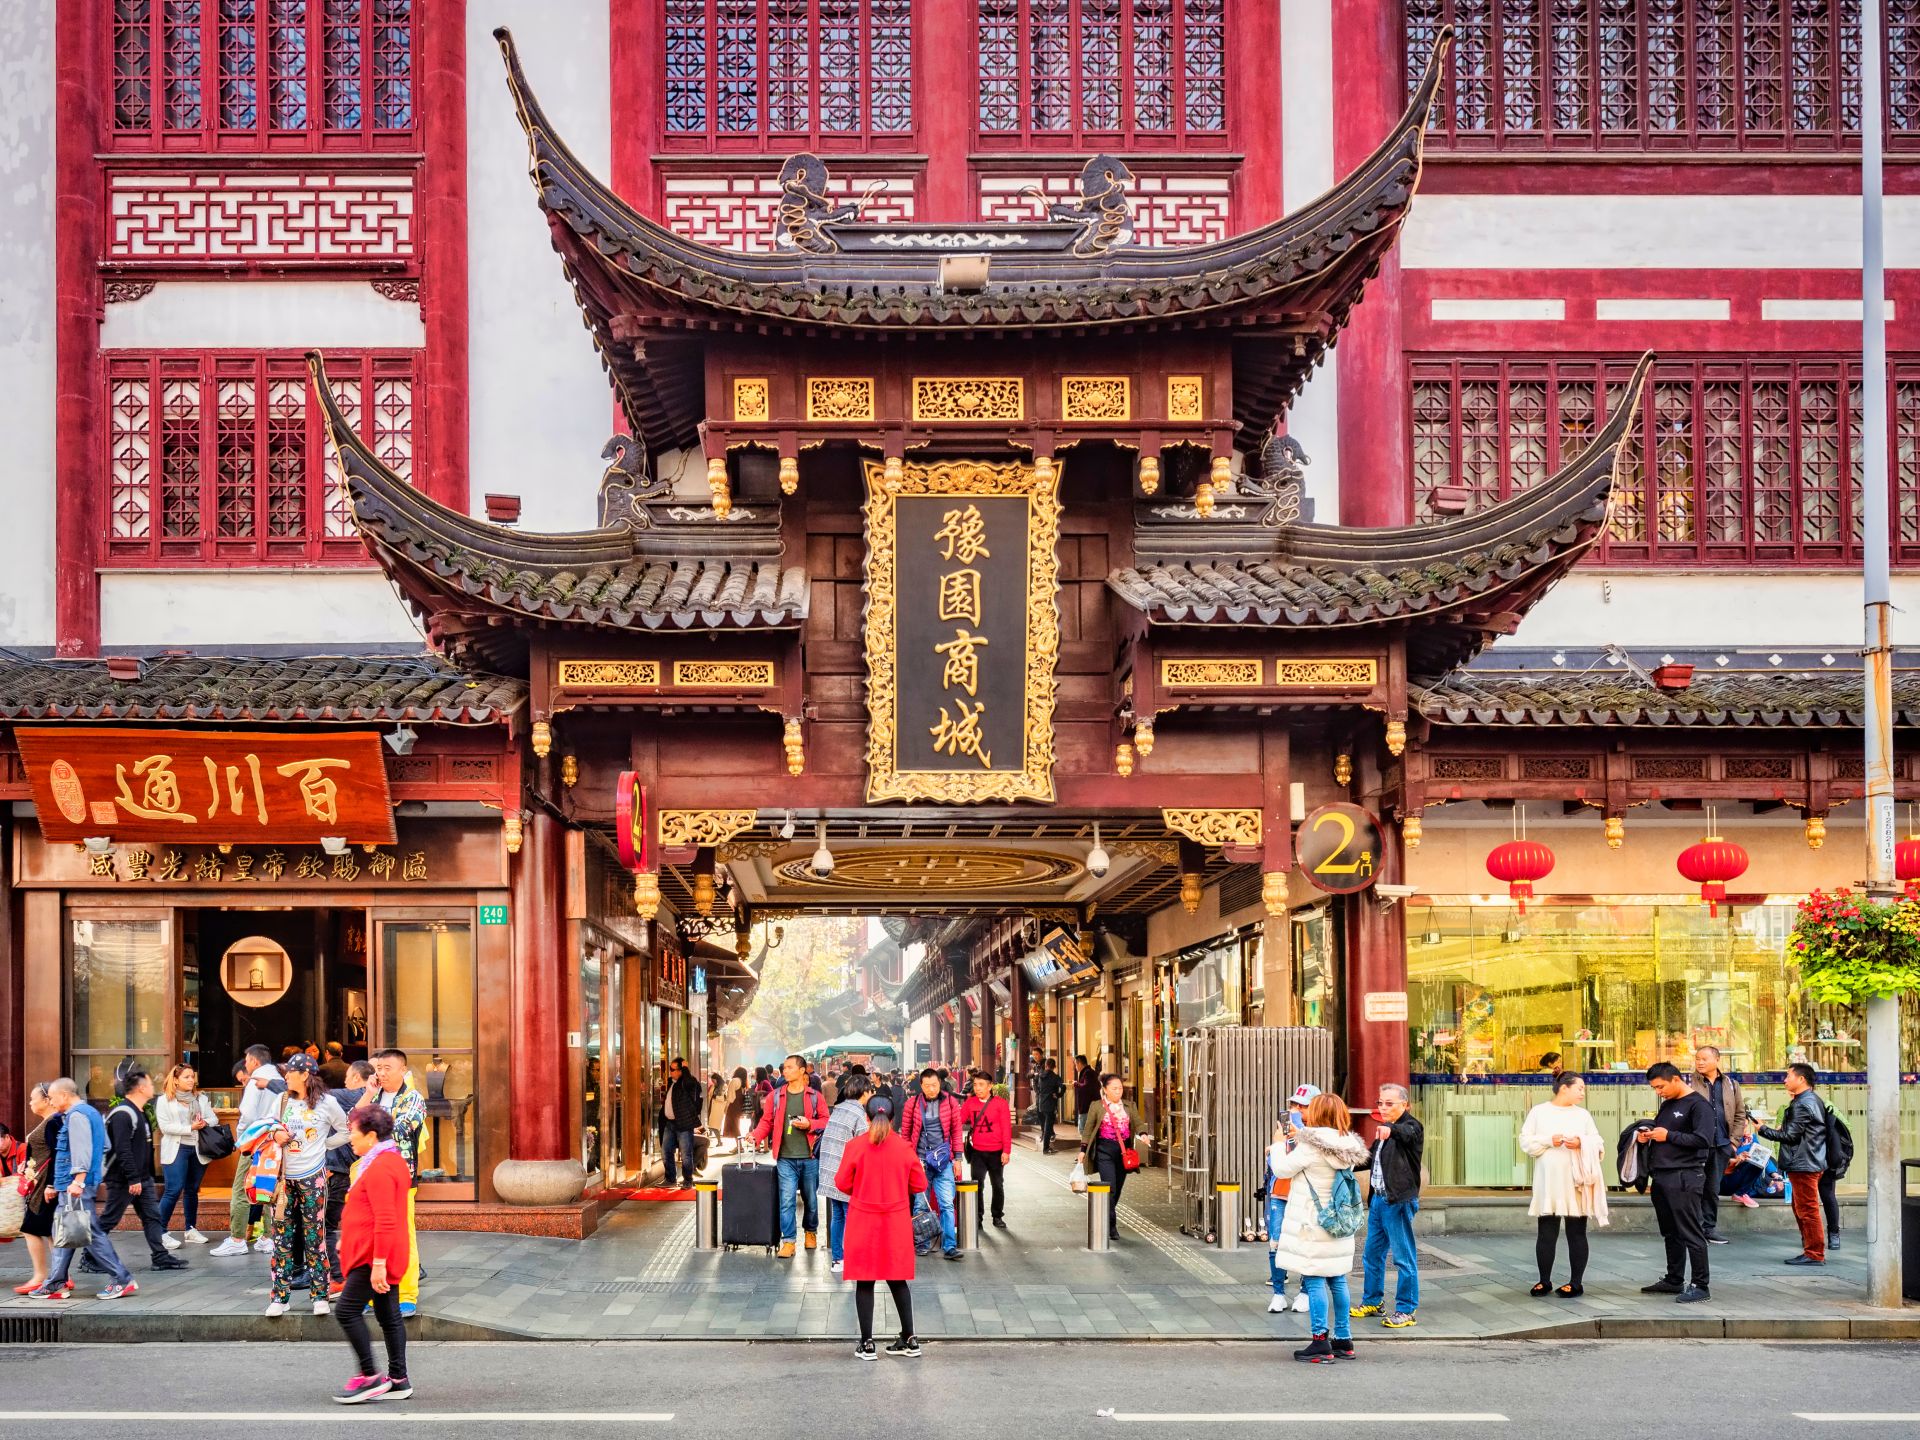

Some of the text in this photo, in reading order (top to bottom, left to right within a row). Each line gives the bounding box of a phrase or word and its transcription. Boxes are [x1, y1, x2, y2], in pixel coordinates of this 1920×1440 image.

[930, 504, 992, 769] 豫園商城
[484, 907, 503, 918] 240
